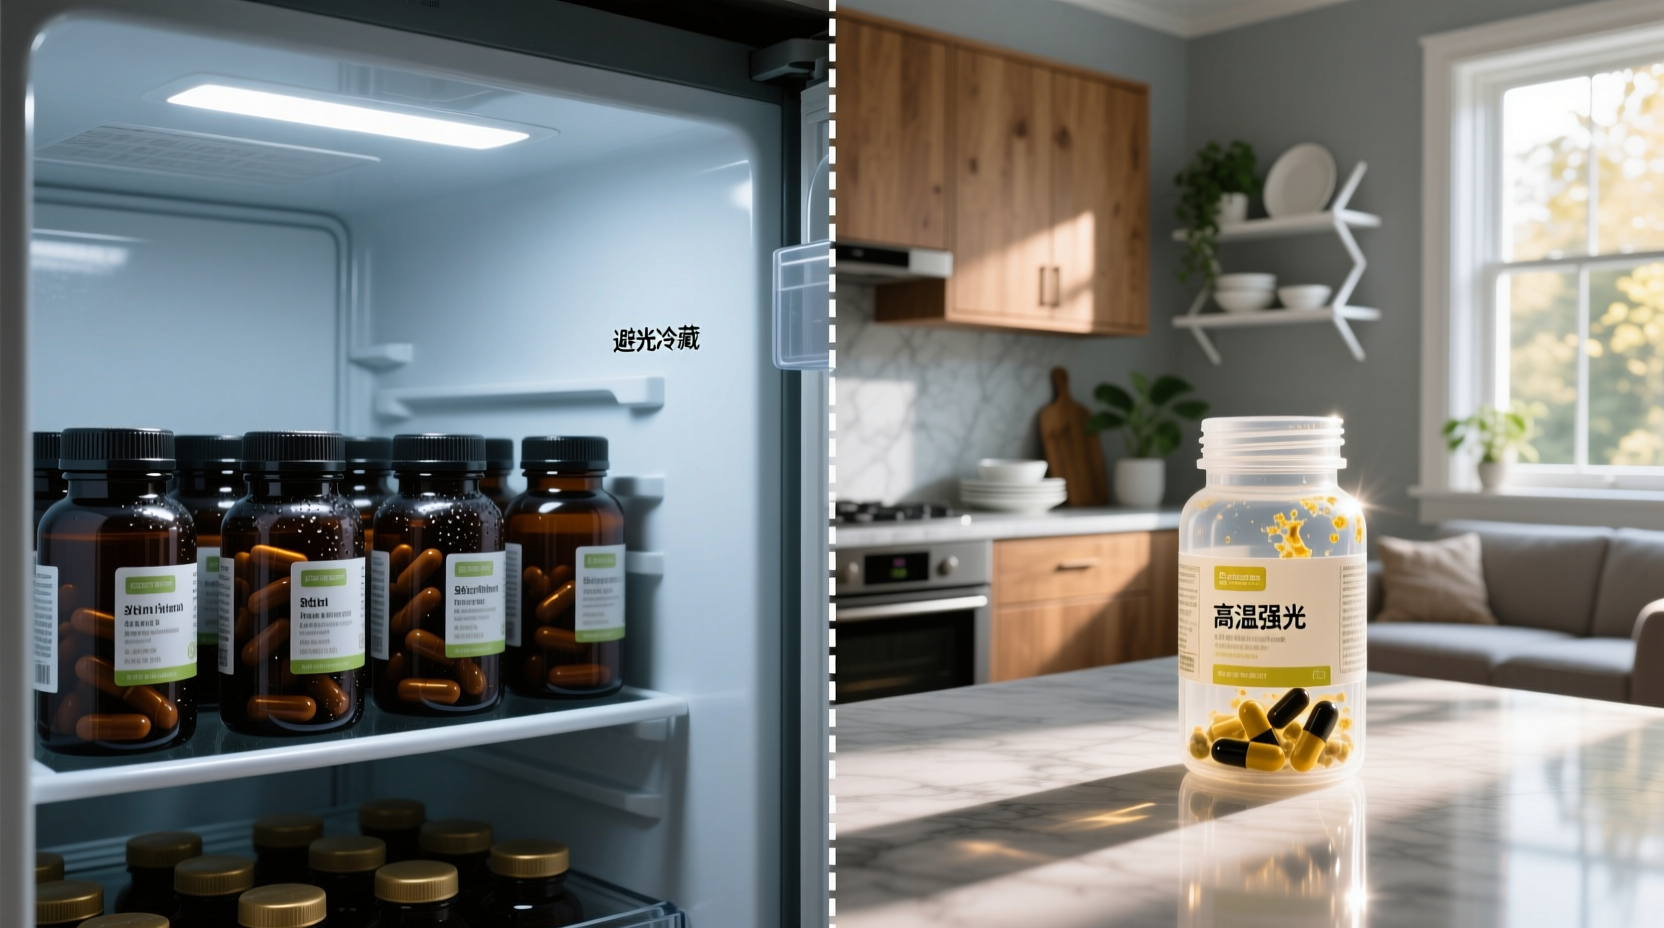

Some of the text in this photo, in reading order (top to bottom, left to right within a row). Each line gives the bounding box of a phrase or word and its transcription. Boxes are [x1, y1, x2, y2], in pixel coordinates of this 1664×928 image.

[613, 324, 700, 353] 避光冷藏
[1213, 602, 1307, 631] 高温强光
